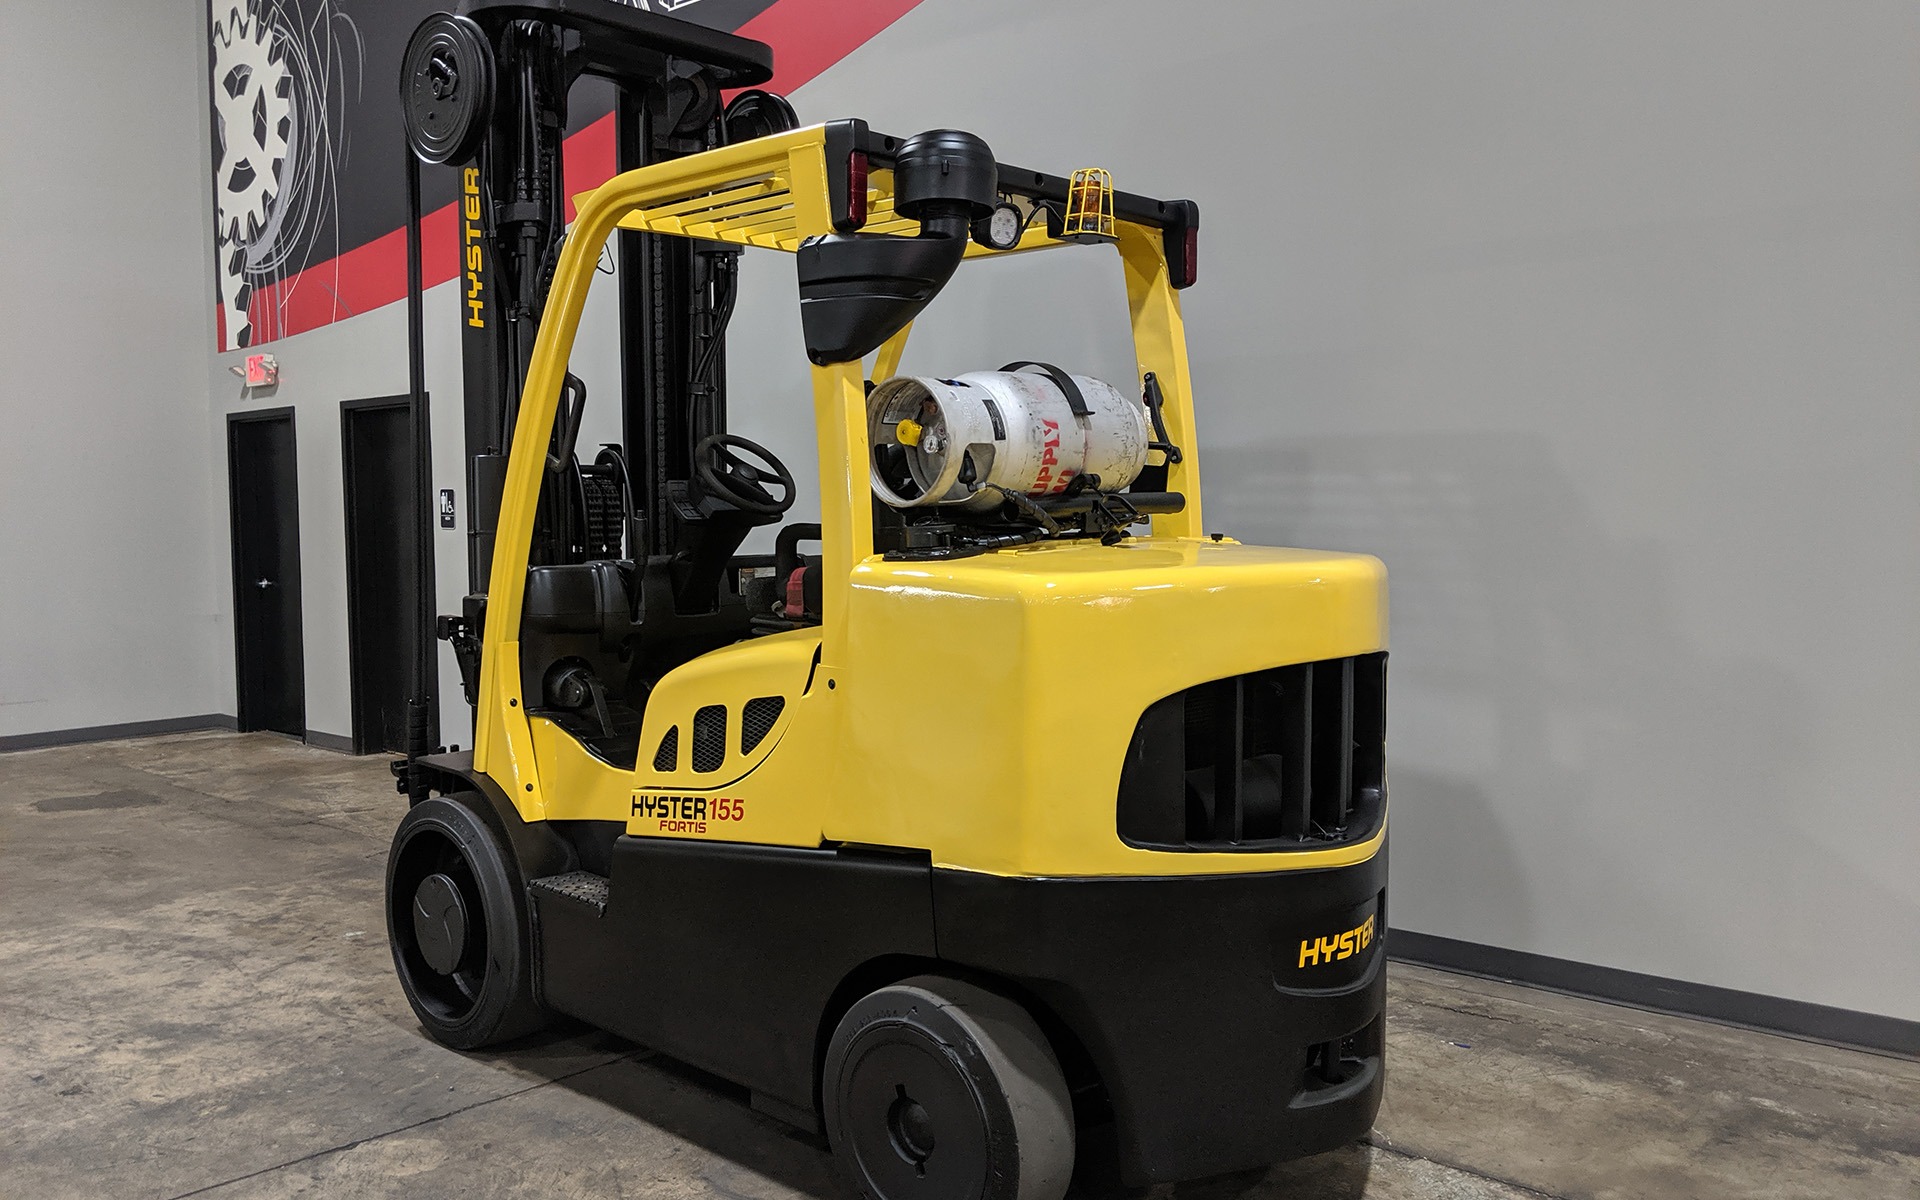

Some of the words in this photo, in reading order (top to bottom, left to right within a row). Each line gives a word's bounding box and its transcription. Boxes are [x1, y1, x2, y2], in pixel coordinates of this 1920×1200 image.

[463, 167, 485, 328] HYSTER
[631, 795, 707, 820] HYSTER
[709, 798, 745, 822] 155
[659, 820, 707, 834] FORTIS
[1298, 914, 1375, 968] HYSTER
